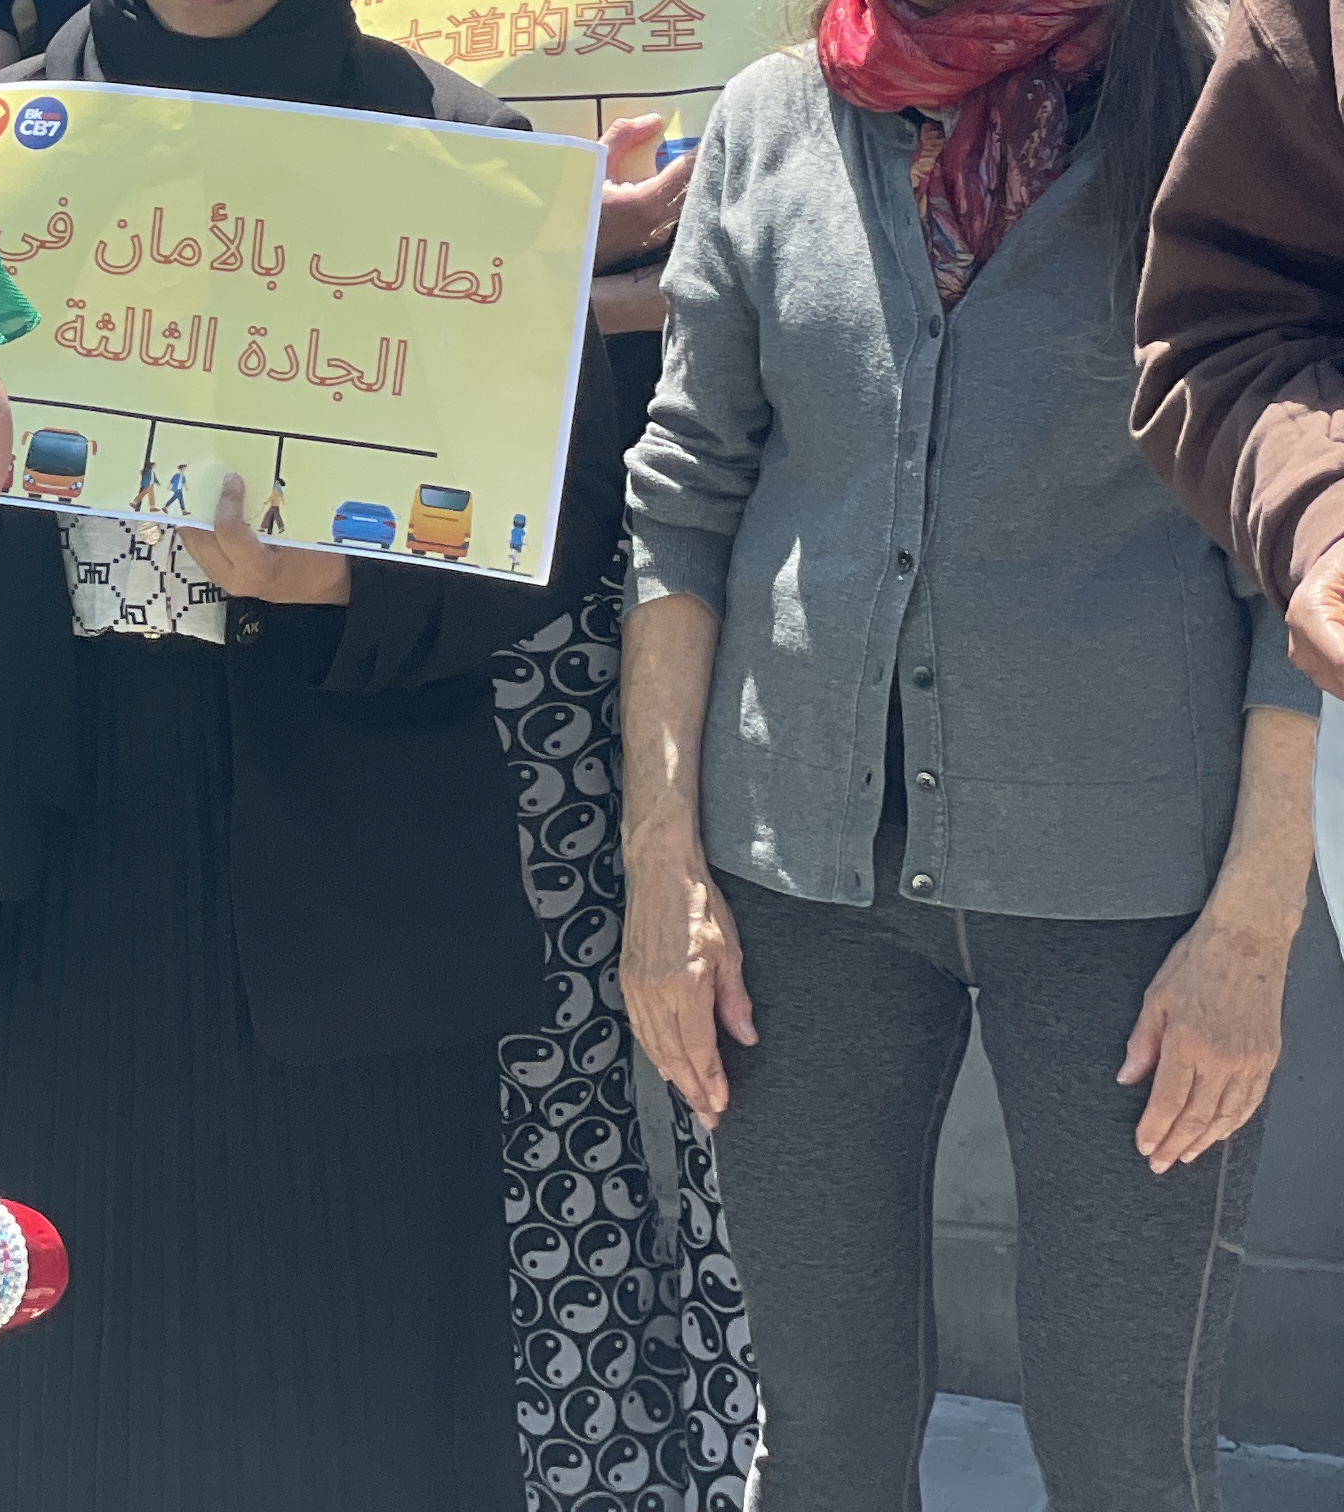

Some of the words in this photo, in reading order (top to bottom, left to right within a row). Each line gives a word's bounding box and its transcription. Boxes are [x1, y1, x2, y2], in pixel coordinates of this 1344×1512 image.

[19, 119, 62, 137] CB7
[95, 203, 286, 292] بالأمان
[309, 235, 504, 305] نطالب
[54, 297, 218, 373] الثالثة
[238, 324, 408, 403] الجادة
